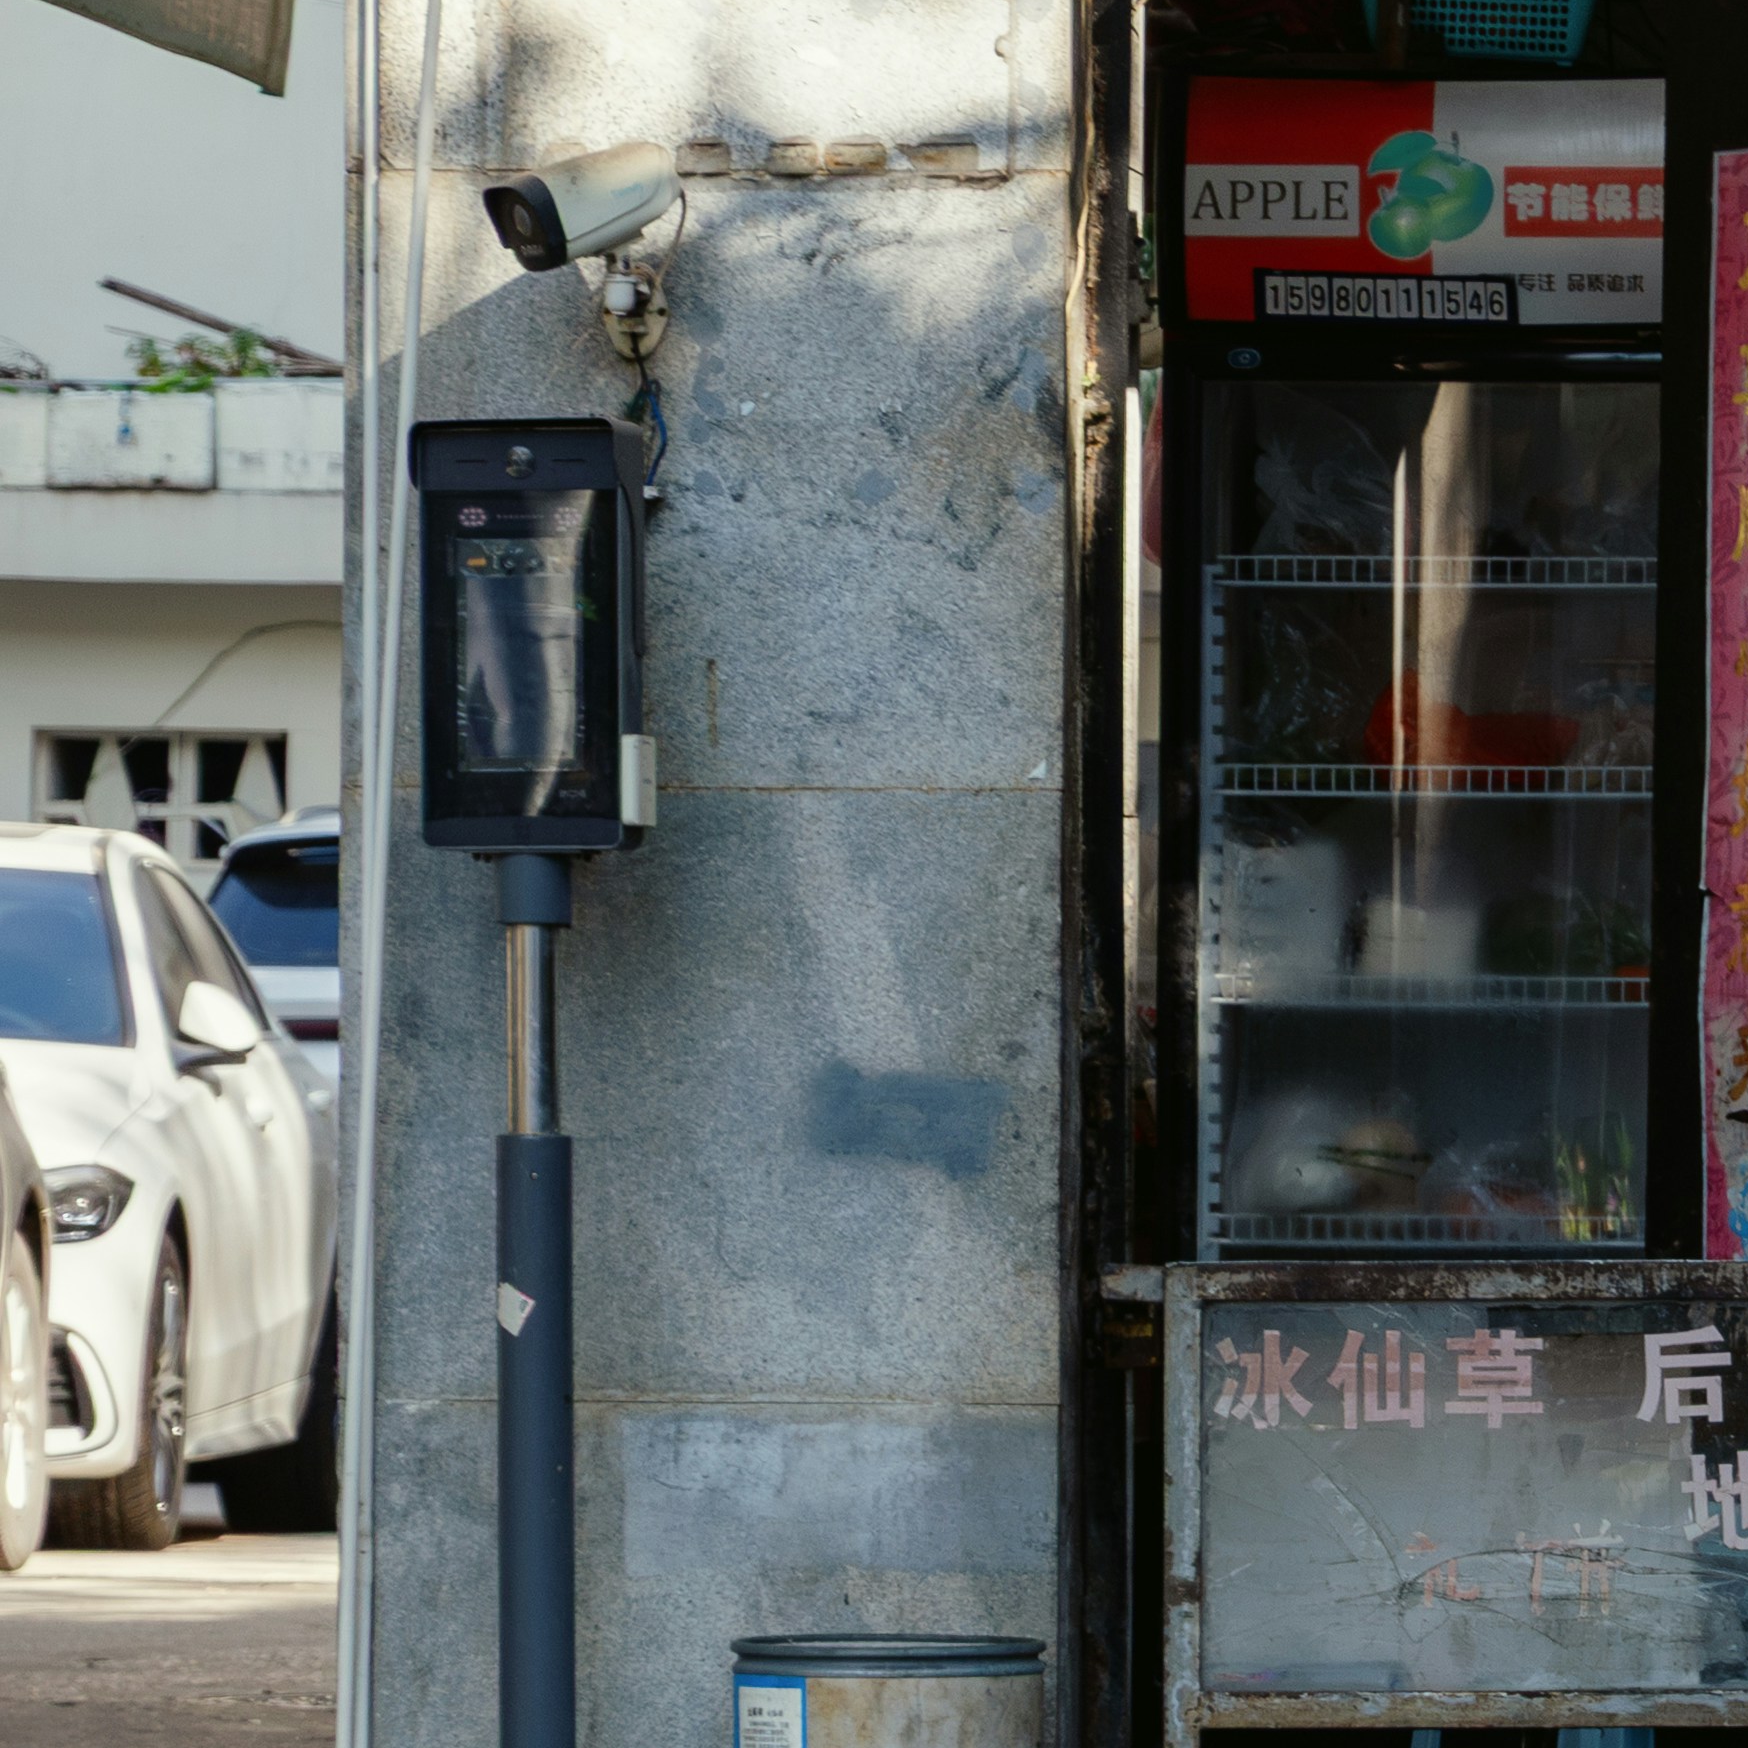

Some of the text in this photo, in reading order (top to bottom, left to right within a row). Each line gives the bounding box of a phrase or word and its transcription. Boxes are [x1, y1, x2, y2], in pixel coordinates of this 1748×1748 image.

[1190, 179, 1350, 221] APPLE
[1268, 283, 1506, 318] 15980111546
[1567, 273, 1645, 293] 品质追求
[1213, 1329, 1544, 1431] 冰仙草
